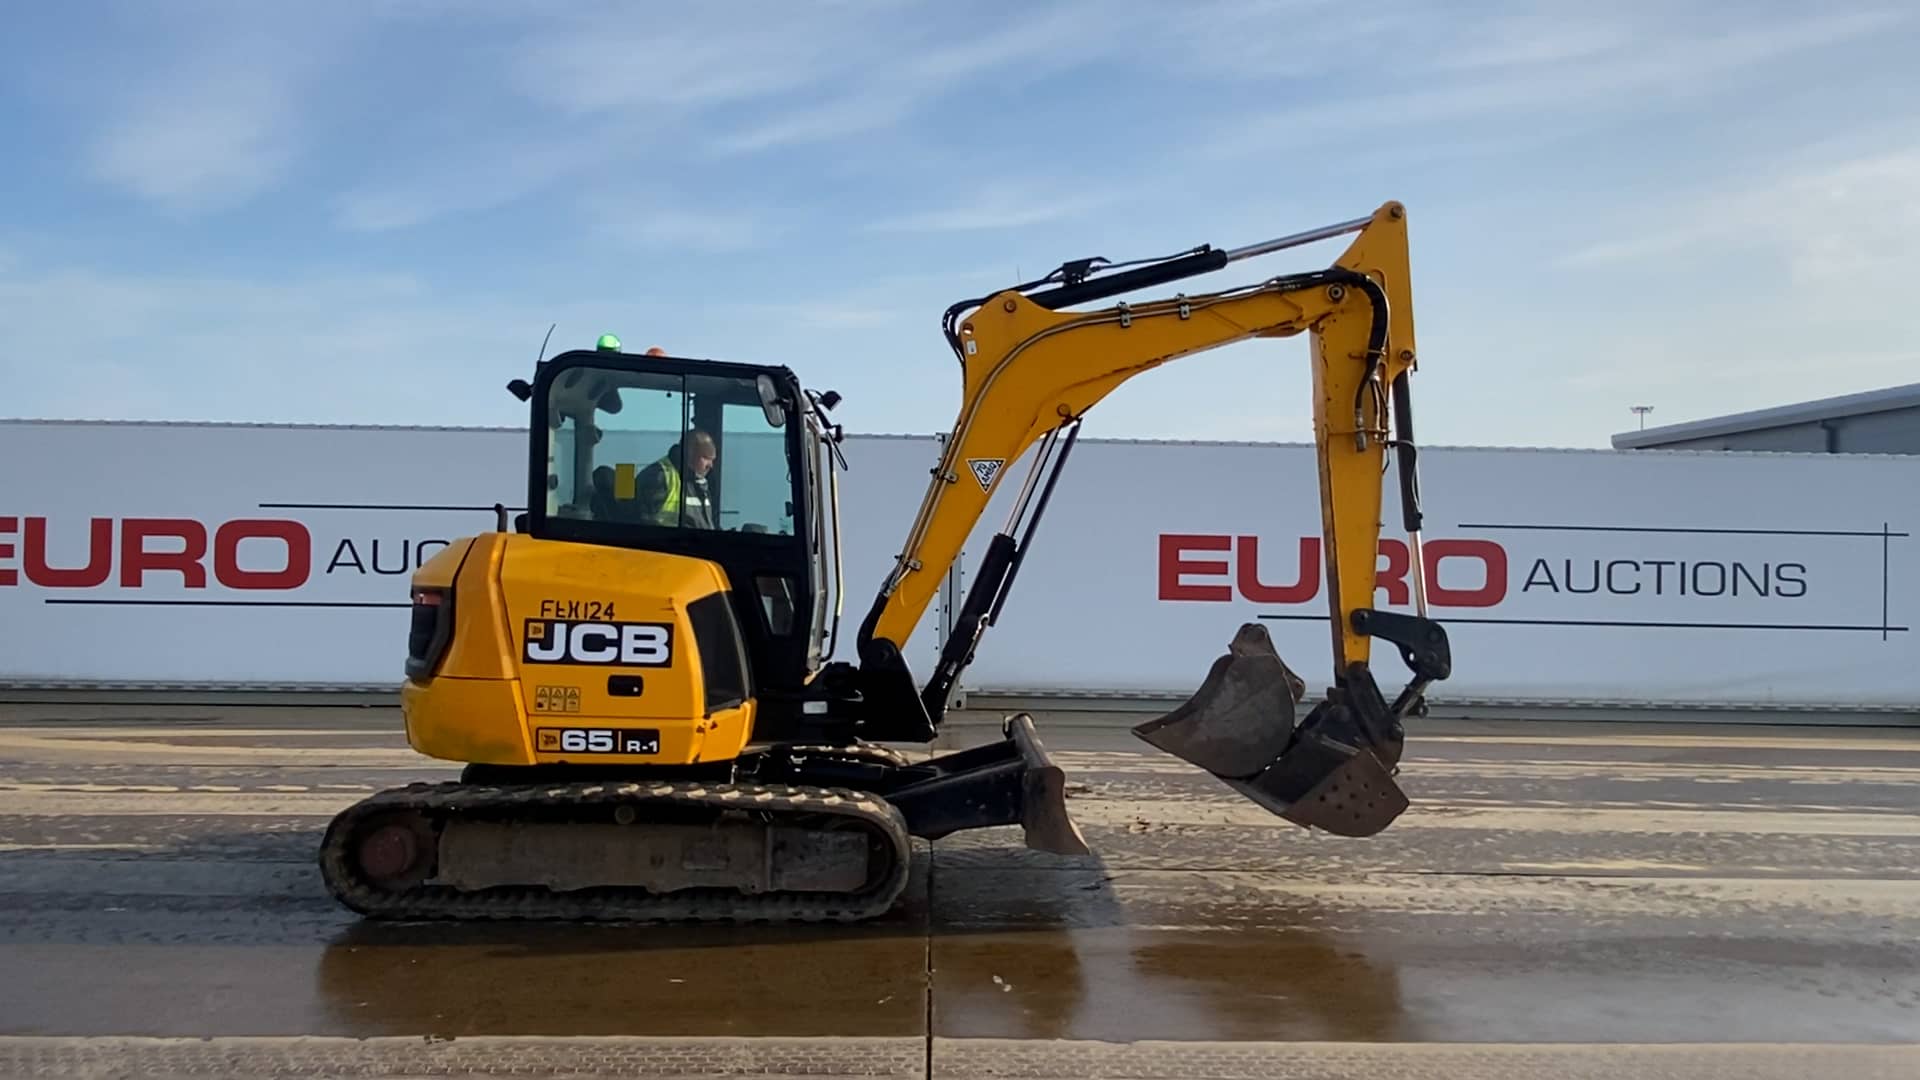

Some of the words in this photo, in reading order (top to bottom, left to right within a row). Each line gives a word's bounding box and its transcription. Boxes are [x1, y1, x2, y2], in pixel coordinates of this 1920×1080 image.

[0, 518, 311, 589] URO
[1522, 558, 1807, 597] AUCTIONS
[527, 623, 669, 663] JCB
[562, 730, 613, 752] 65
[626, 740, 658, 752] R-1
